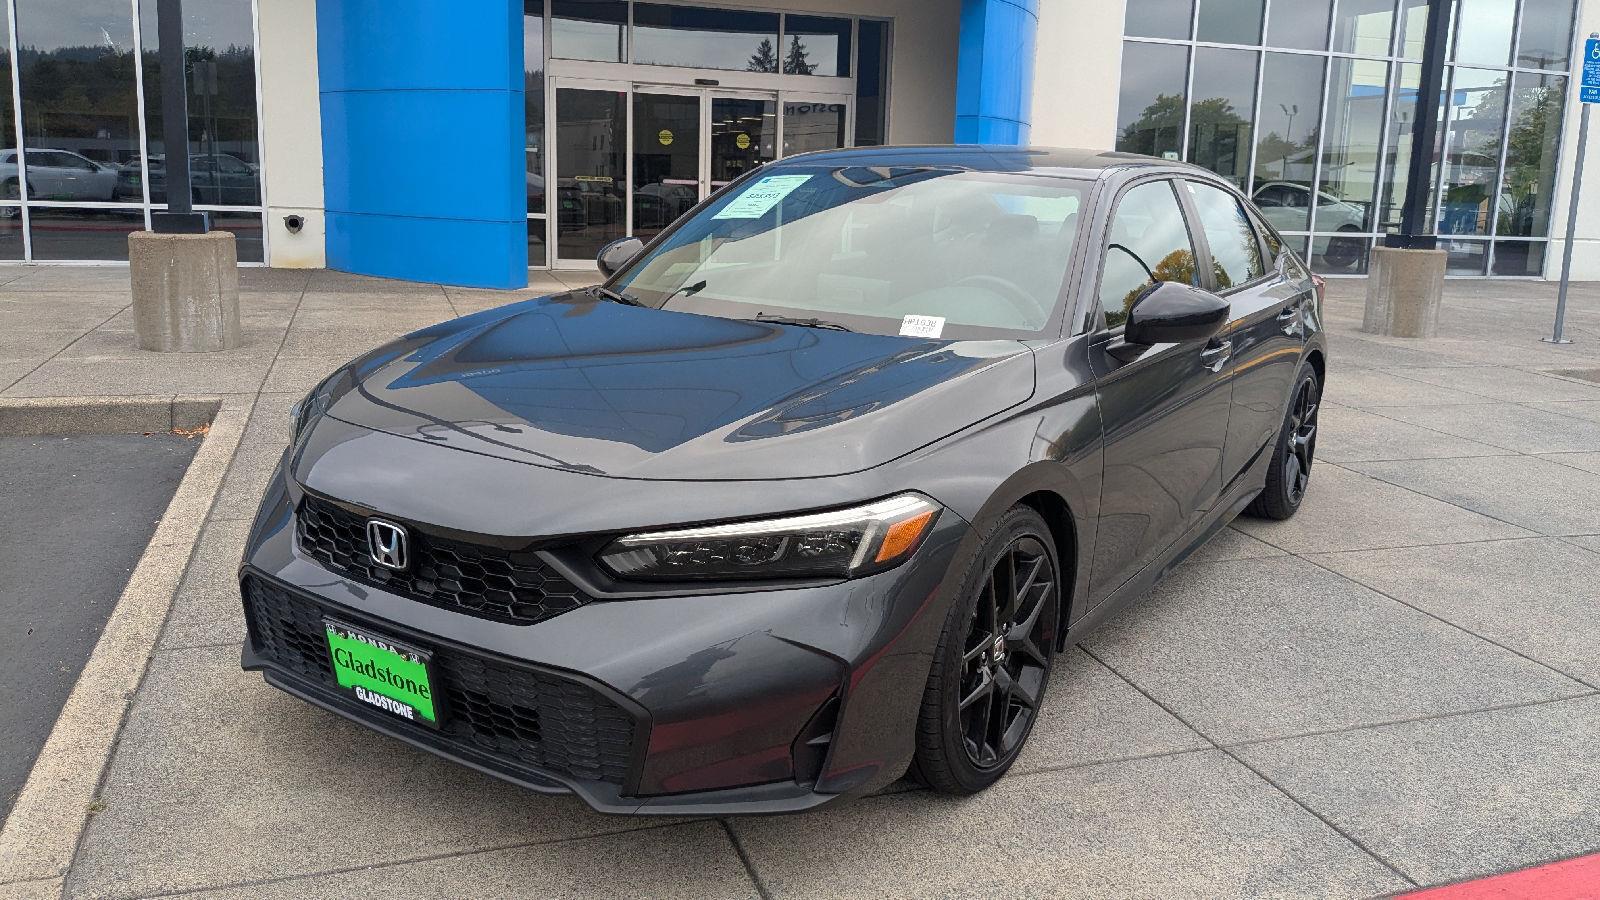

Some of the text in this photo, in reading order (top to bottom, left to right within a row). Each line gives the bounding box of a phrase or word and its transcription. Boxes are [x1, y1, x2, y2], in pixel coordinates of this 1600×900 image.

[347, 630, 398, 654] HONDA
[334, 647, 430, 700] Gladstone
[355, 686, 414, 720] GLADSTONE
